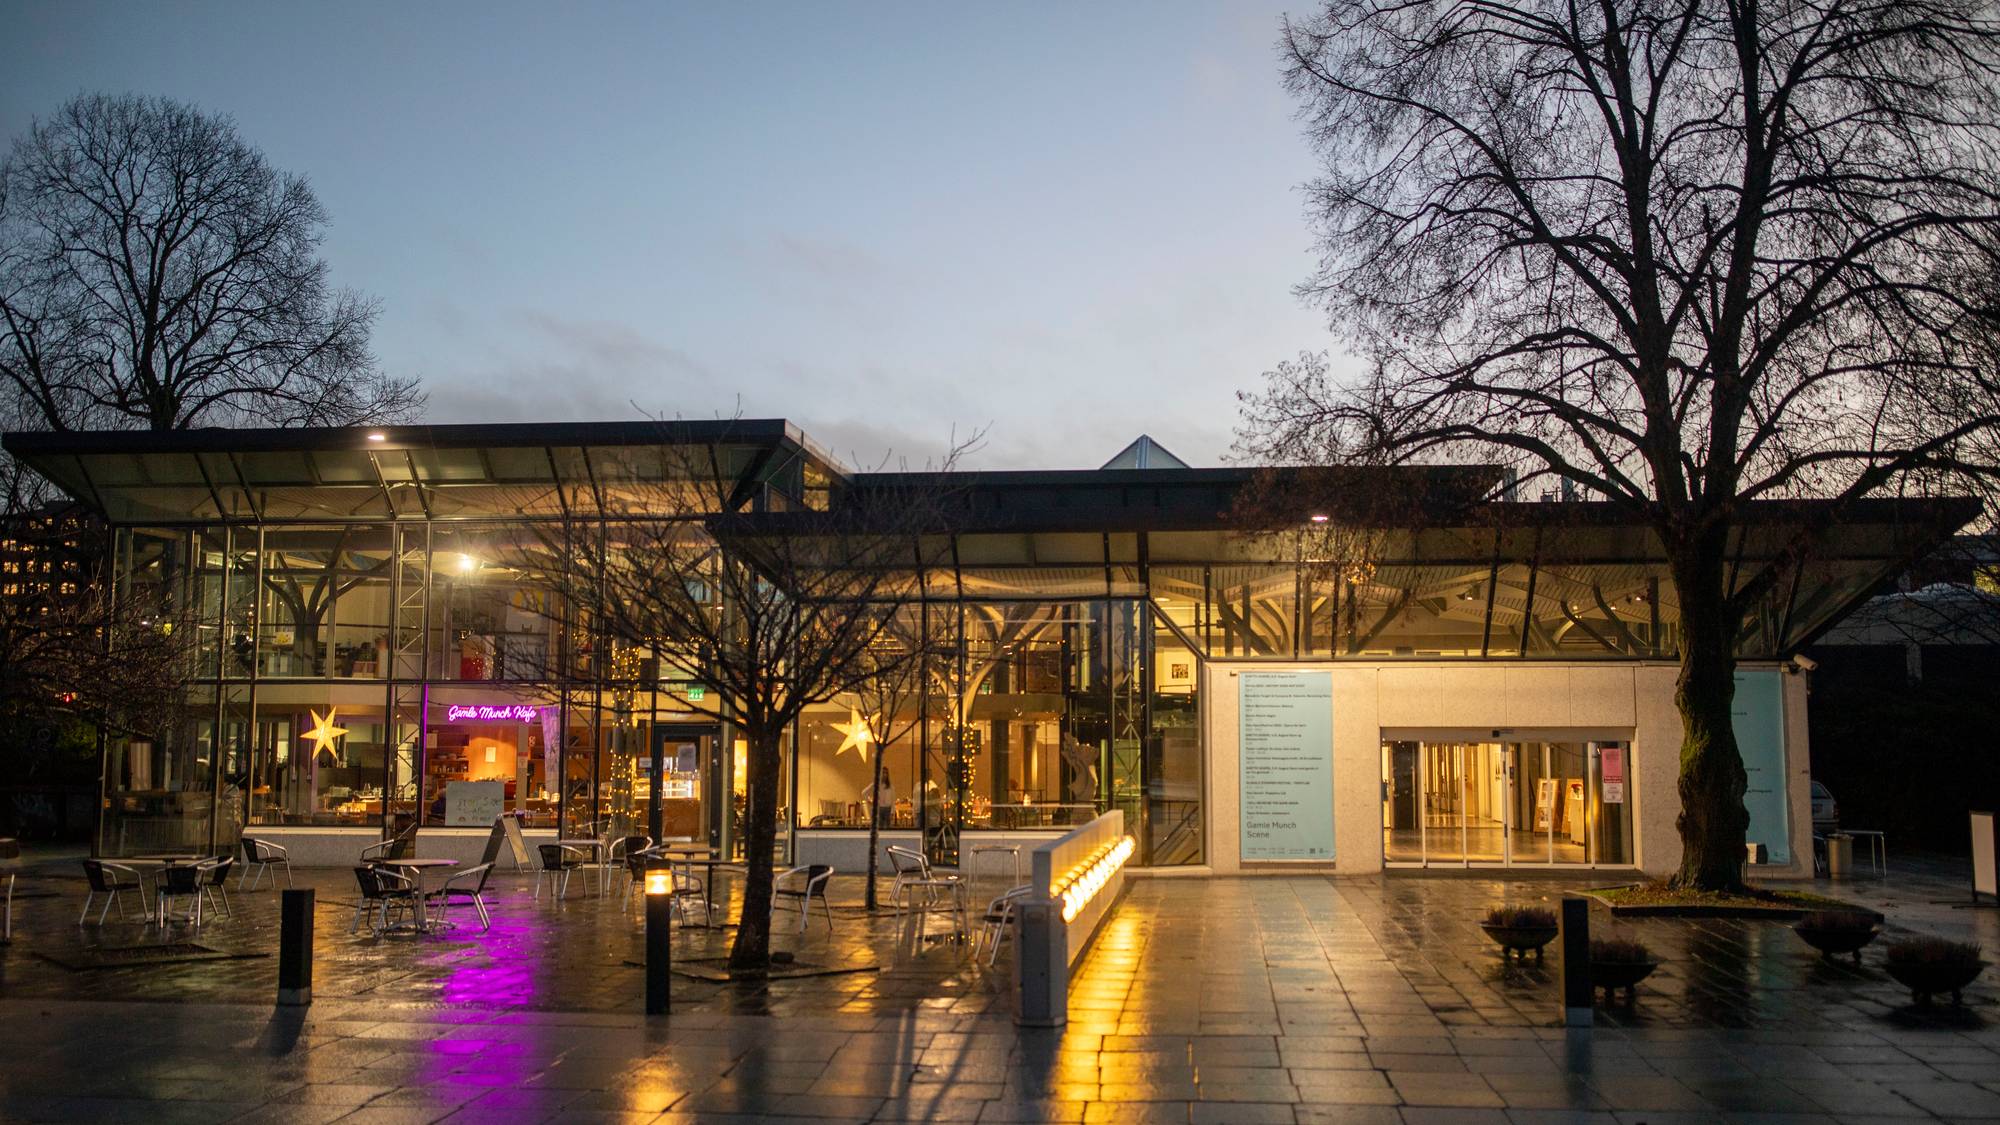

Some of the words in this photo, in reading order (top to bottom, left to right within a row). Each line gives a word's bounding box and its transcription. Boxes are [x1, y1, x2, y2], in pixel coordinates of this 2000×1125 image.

[448, 705, 477, 721] Gamle
[479, 706, 512, 719] Munch
[513, 706, 537, 723] Kafe
[1246, 821, 1271, 830] Gamle
[1272, 821, 1297, 830] Munch
[1247, 831, 1270, 839] Scene
